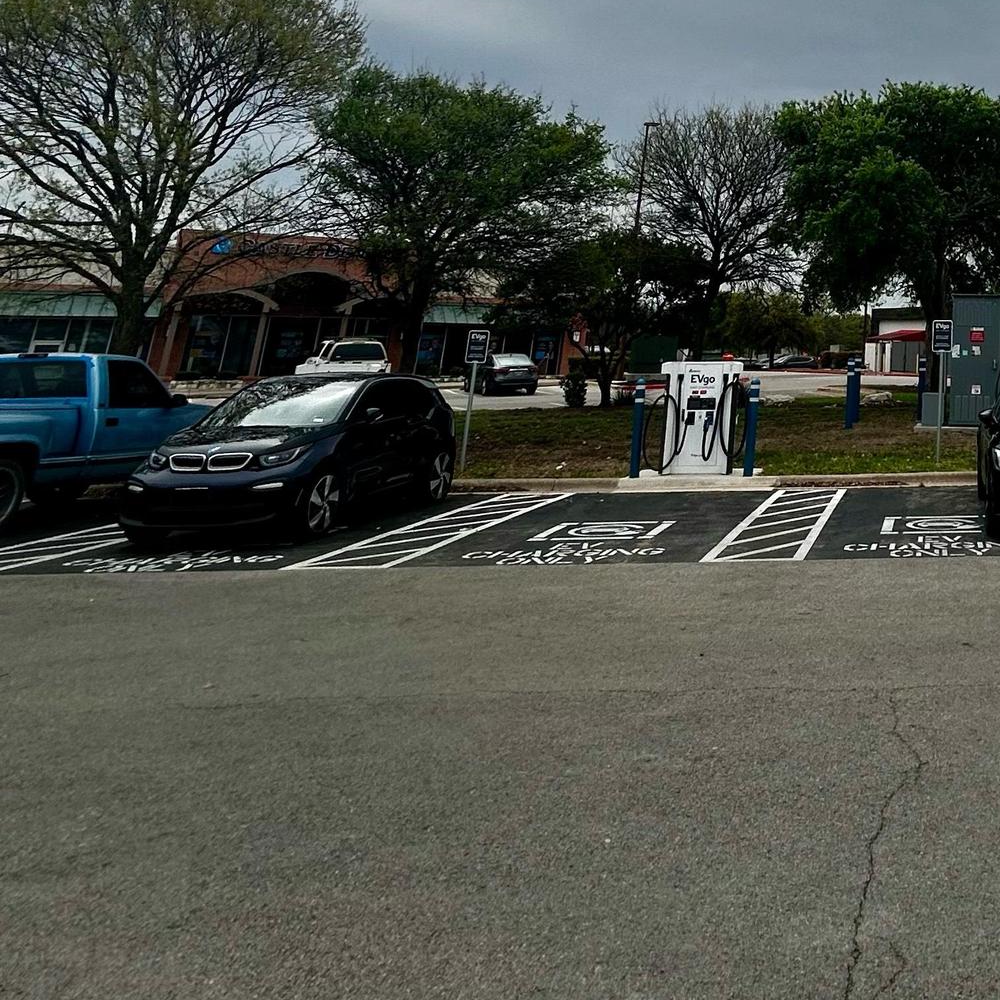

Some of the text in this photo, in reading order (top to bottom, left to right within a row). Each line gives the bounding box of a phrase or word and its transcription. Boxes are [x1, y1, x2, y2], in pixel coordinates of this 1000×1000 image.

[690, 375, 716, 385] EVgo
[549, 542, 604, 550] EV
[462, 547, 665, 558] CHARGING
[890, 549, 989, 557] ONLY
[496, 555, 608, 564] ONLY
